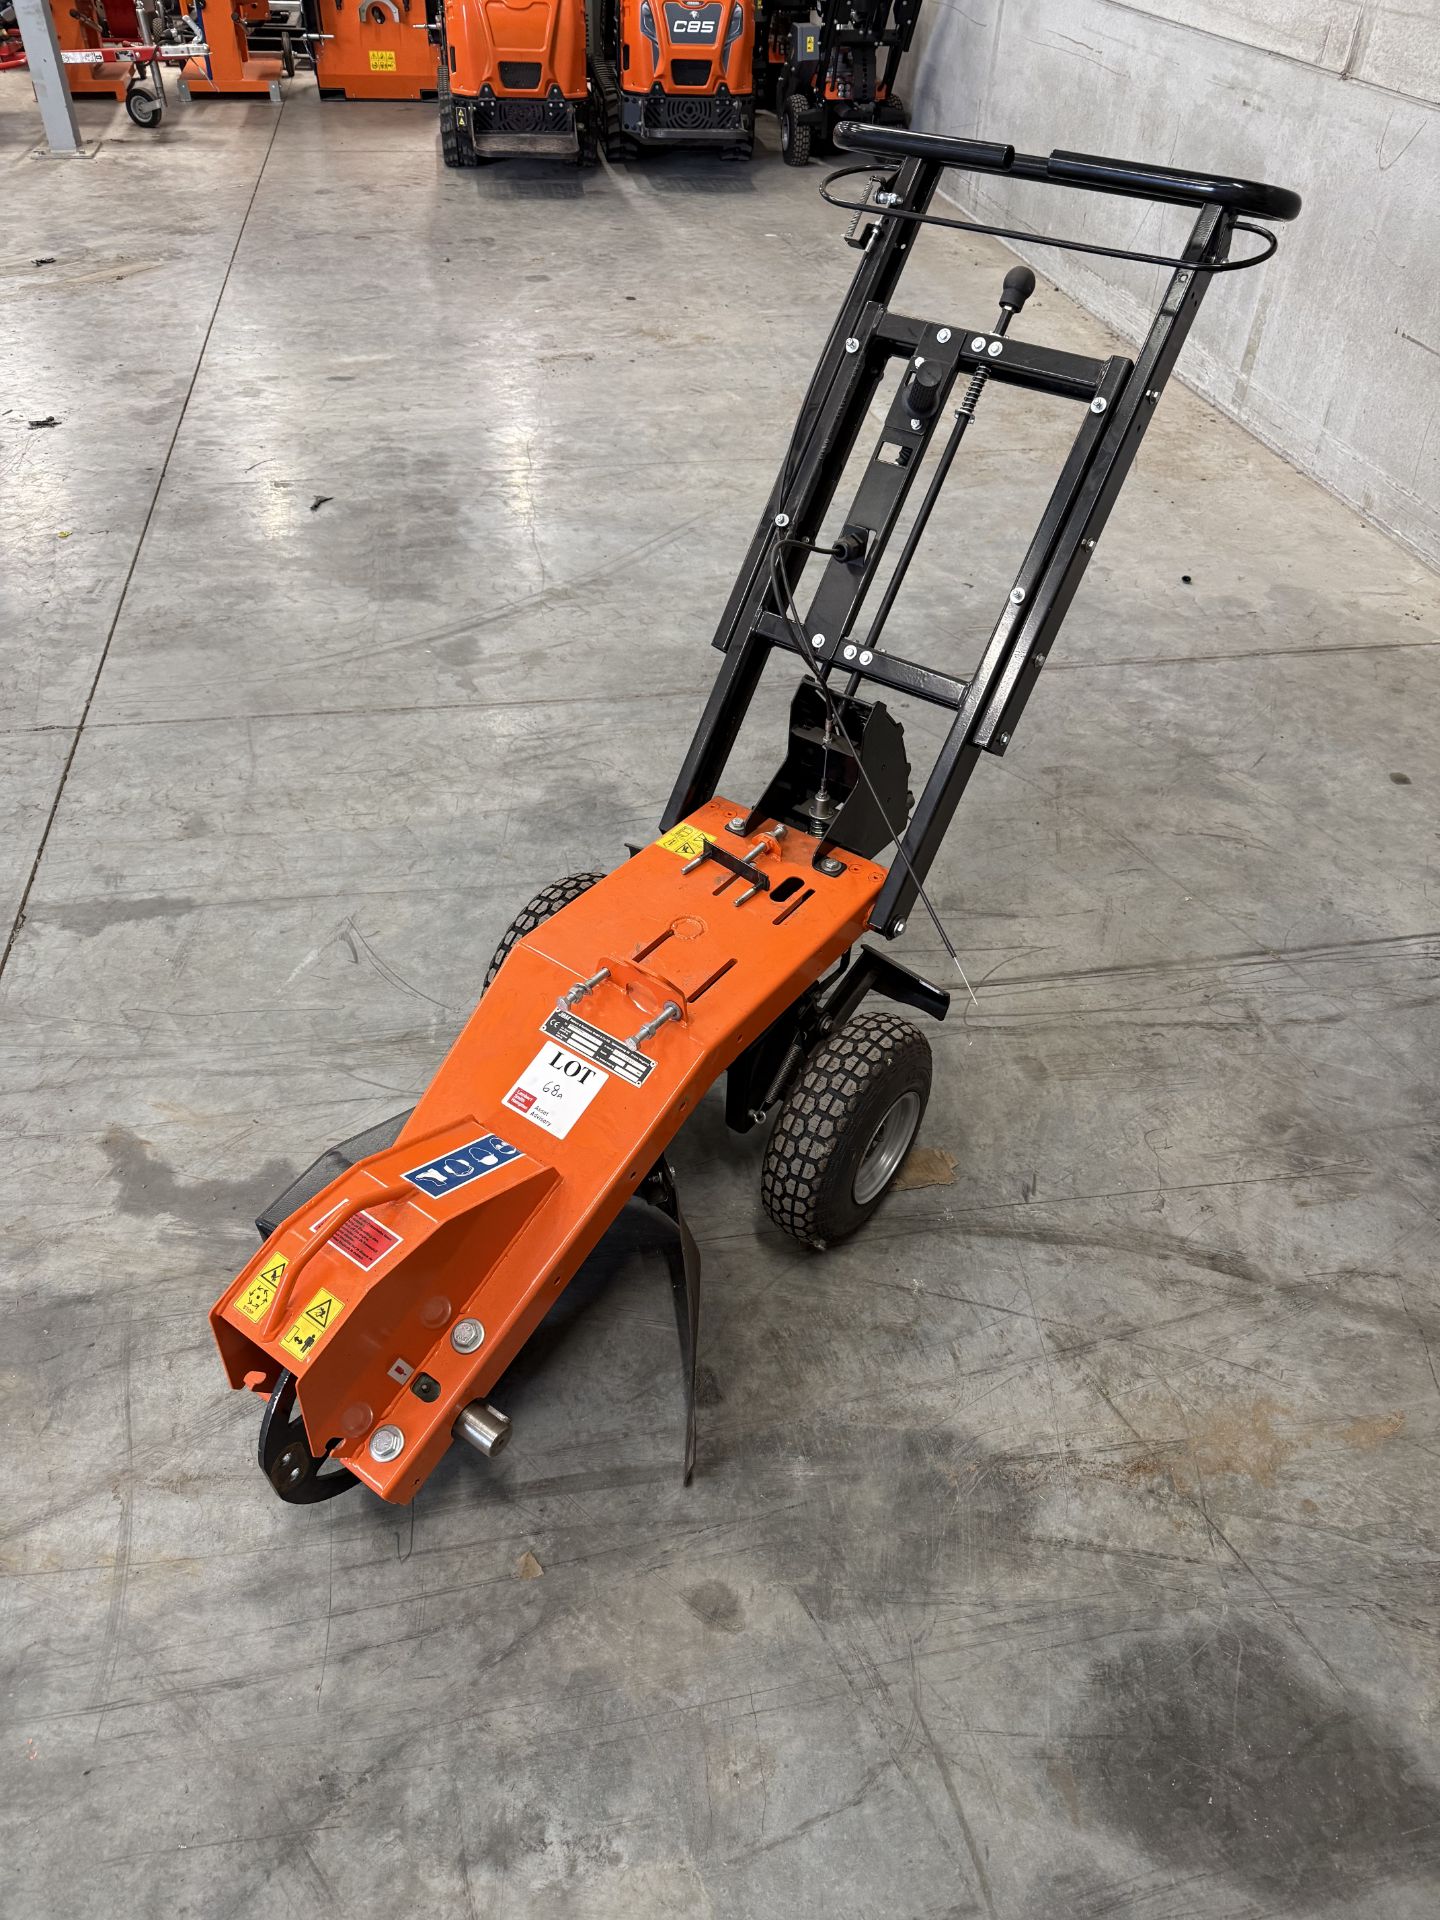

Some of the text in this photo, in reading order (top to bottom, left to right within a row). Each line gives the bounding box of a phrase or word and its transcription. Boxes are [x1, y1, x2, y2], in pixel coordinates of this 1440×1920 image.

[673, 20, 715, 33] C85
[548, 1051, 596, 1084] LOT
[534, 1105, 549, 1117] Asset
[529, 1111, 552, 1127] Advisory
